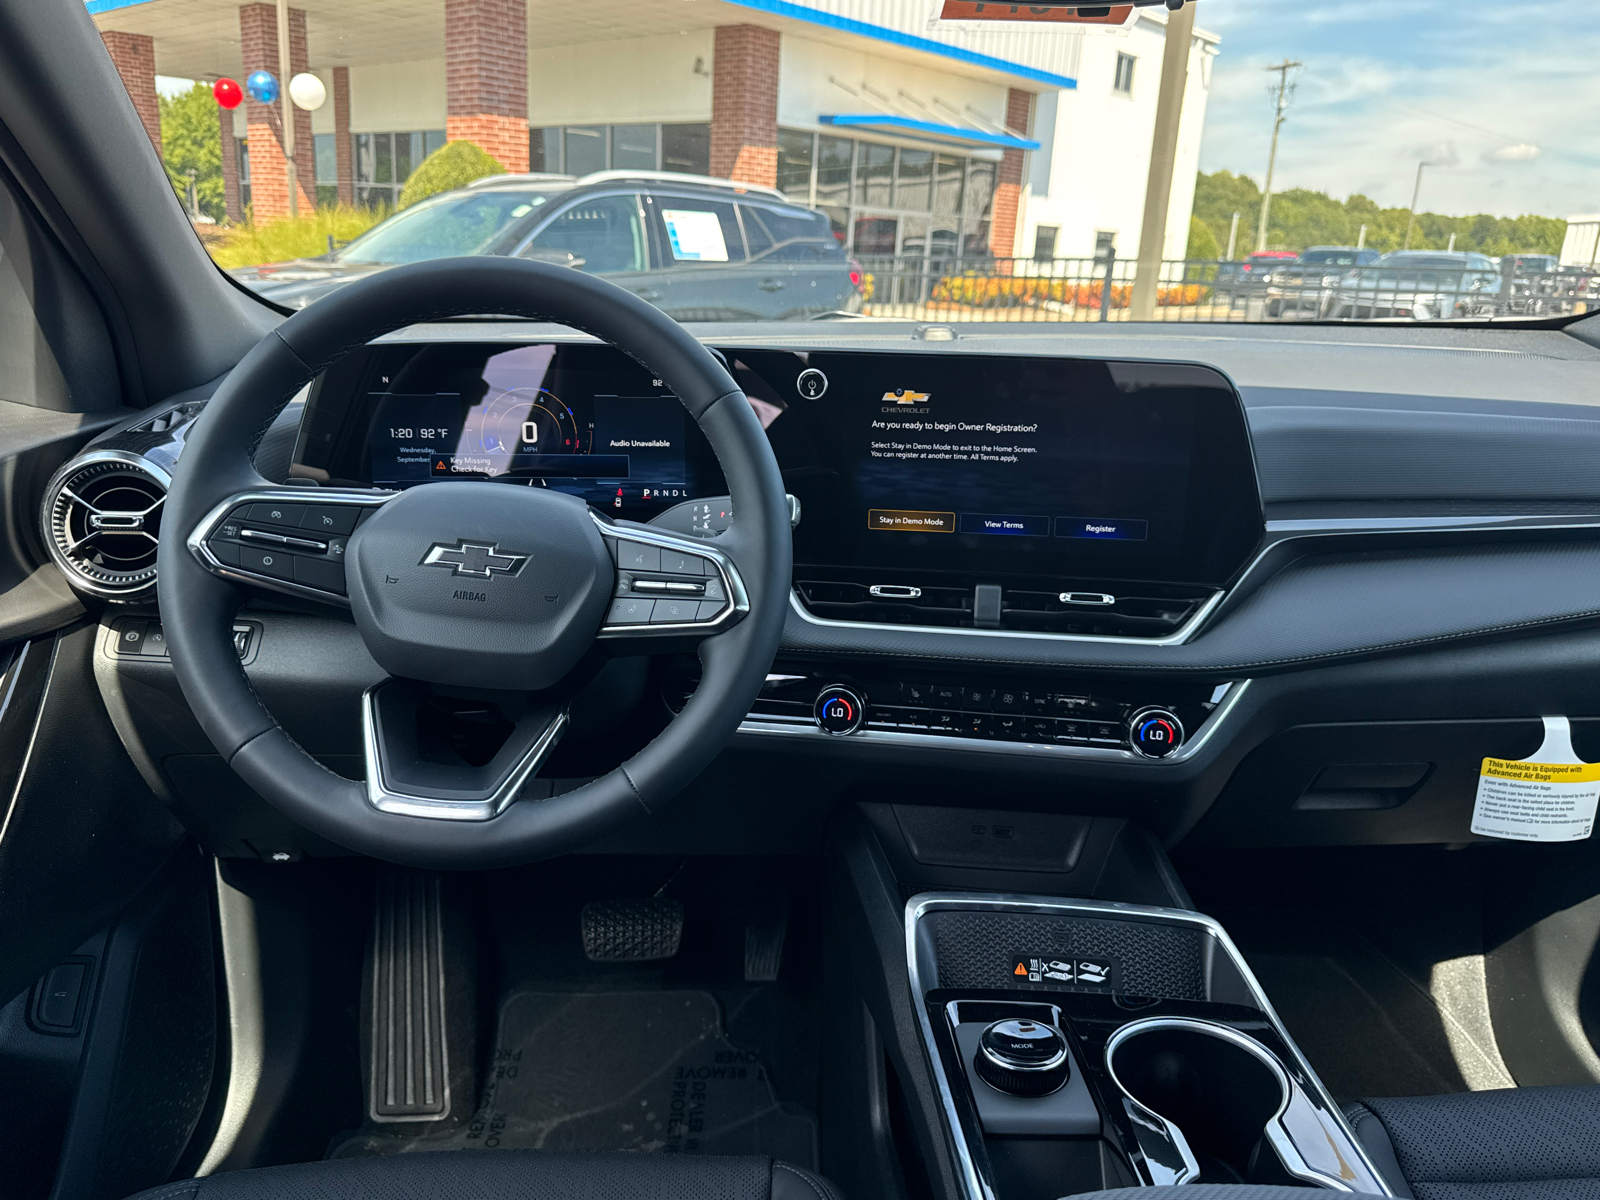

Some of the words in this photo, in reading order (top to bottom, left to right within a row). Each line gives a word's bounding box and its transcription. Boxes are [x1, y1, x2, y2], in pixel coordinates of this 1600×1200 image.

[381, 376, 389, 384] N
[881, 406, 931, 414] CHEVROLET
[559, 412, 565, 420] 5
[871, 420, 885, 428] Are
[886, 422, 900, 431] you
[902, 421, 923, 431] ready
[924, 422, 933, 430] to
[934, 421, 957, 432] begin
[957, 422, 984, 431] Owner
[985, 423, 1038, 434] Registration?
[389, 428, 413, 439] 1:20
[419, 428, 435, 439] 92
[521, 421, 538, 444] 0
[565, 438, 571, 446] 6
[609, 439, 630, 447] Audio
[631, 440, 671, 448] Unavailable
[871, 441, 890, 449] Select
[891, 442, 905, 450] Stay
[933, 443, 951, 451] Mode
[399, 447, 437, 455] Wednesday,
[450, 457, 463, 465] Key
[464, 457, 491, 466] Missing
[895, 451, 919, 459] register
[1000, 455, 1018, 463] apply.
[450, 465, 472, 473] Check
[472, 465, 484, 473] for
[484, 466, 498, 474] Key
[643, 488, 651, 497] P
[653, 489, 660, 497] R
[662, 489, 669, 497] N
[672, 489, 679, 497] D
[682, 489, 688, 497] L
[879, 516, 894, 525] Stay
[902, 517, 922, 525] Demo
[923, 518, 944, 526] Mode
[984, 520, 1001, 529] View
[1002, 521, 1024, 530] Terms
[1085, 524, 1116, 534] Register
[453, 590, 487, 602] AIRBAG
[831, 707, 845, 718] LO
[1149, 730, 1164, 740] LO
[1489, 760, 1503, 768] This
[1505, 762, 1531, 771] Vehicle
[1540, 766, 1569, 774] Equipped
[1487, 768, 1522, 778] Advanced
[1535, 773, 1551, 781] Bags
[715, 1050, 758, 1063] OVER
[674, 1066, 746, 1080] REMOVE
[688, 1081, 707, 1133] DEALER
